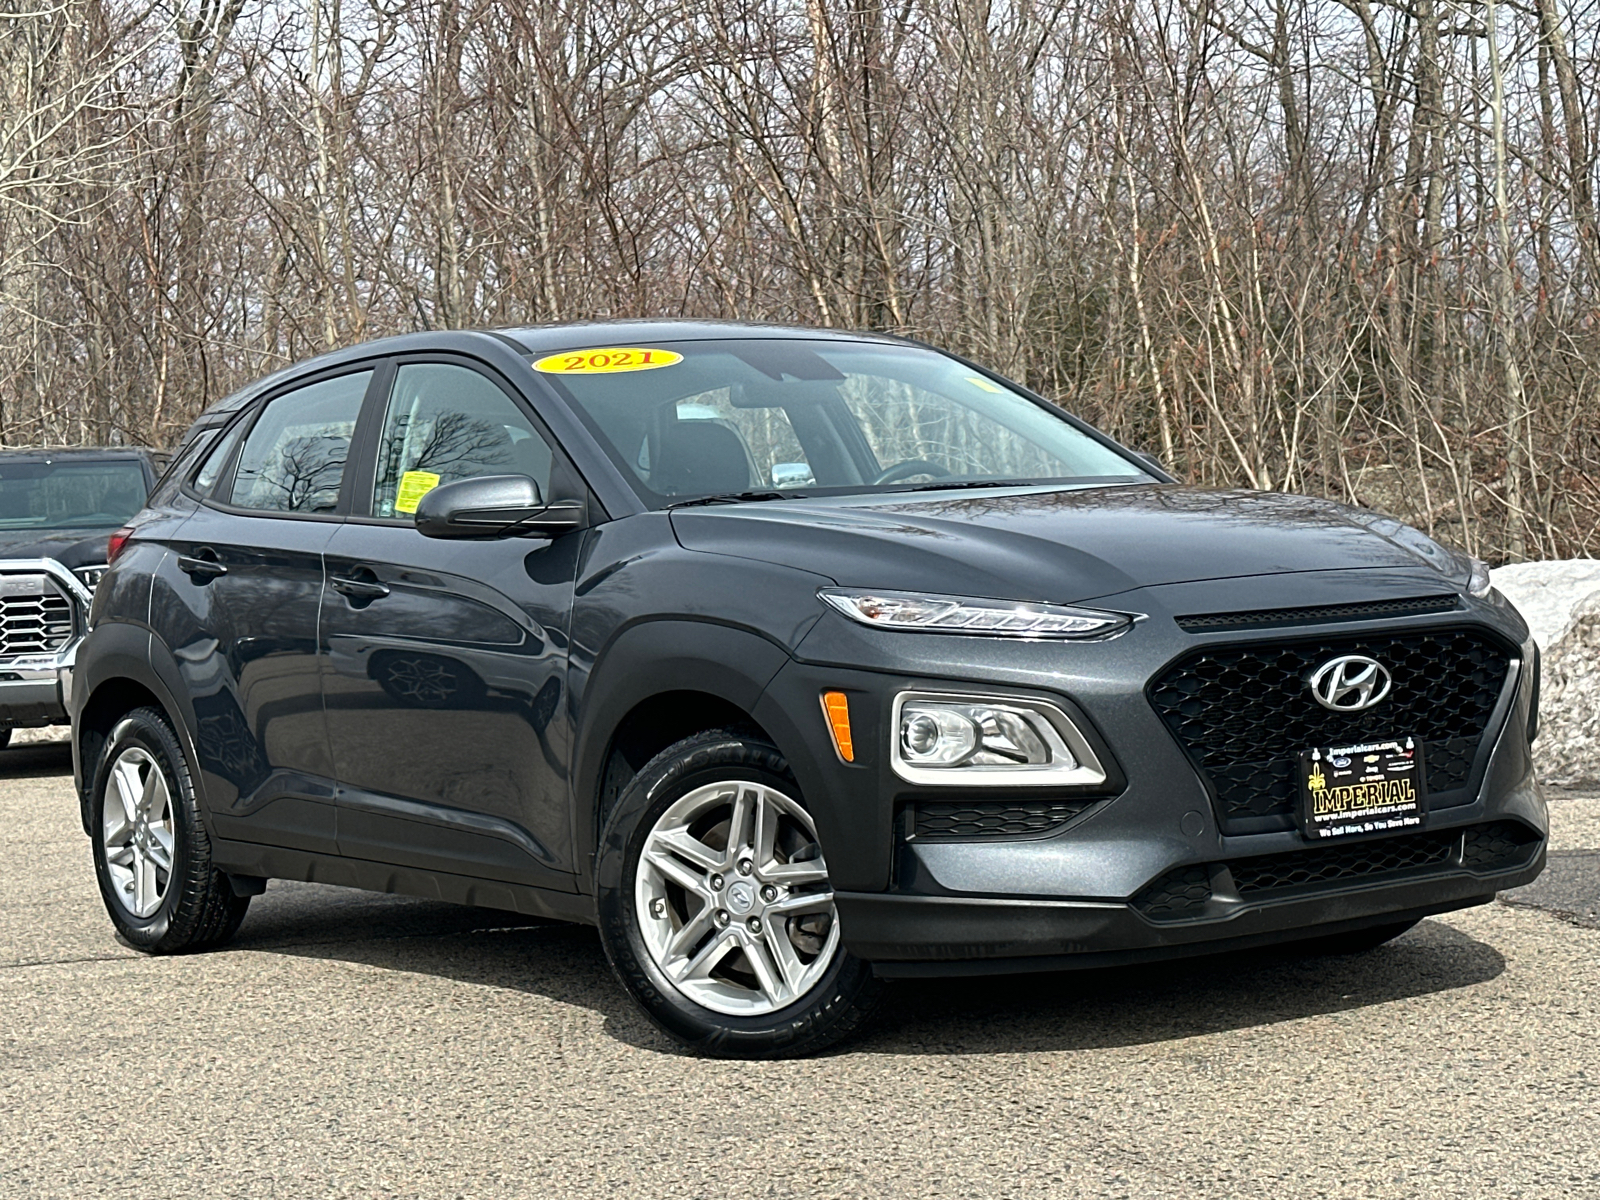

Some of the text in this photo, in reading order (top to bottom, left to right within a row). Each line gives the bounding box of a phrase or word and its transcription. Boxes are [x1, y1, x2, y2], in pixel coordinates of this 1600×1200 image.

[563, 351, 656, 371] 2021
[1313, 778, 1416, 814] IMPERIAL
[1314, 802, 1417, 822] www.imperialcars.com
[1319, 828, 1331, 838] We
[1331, 826, 1344, 836] Sell
[1364, 822, 1373, 831] So
[1374, 821, 1387, 830] You
[1387, 819, 1403, 828] Save
[1403, 817, 1420, 826] More
